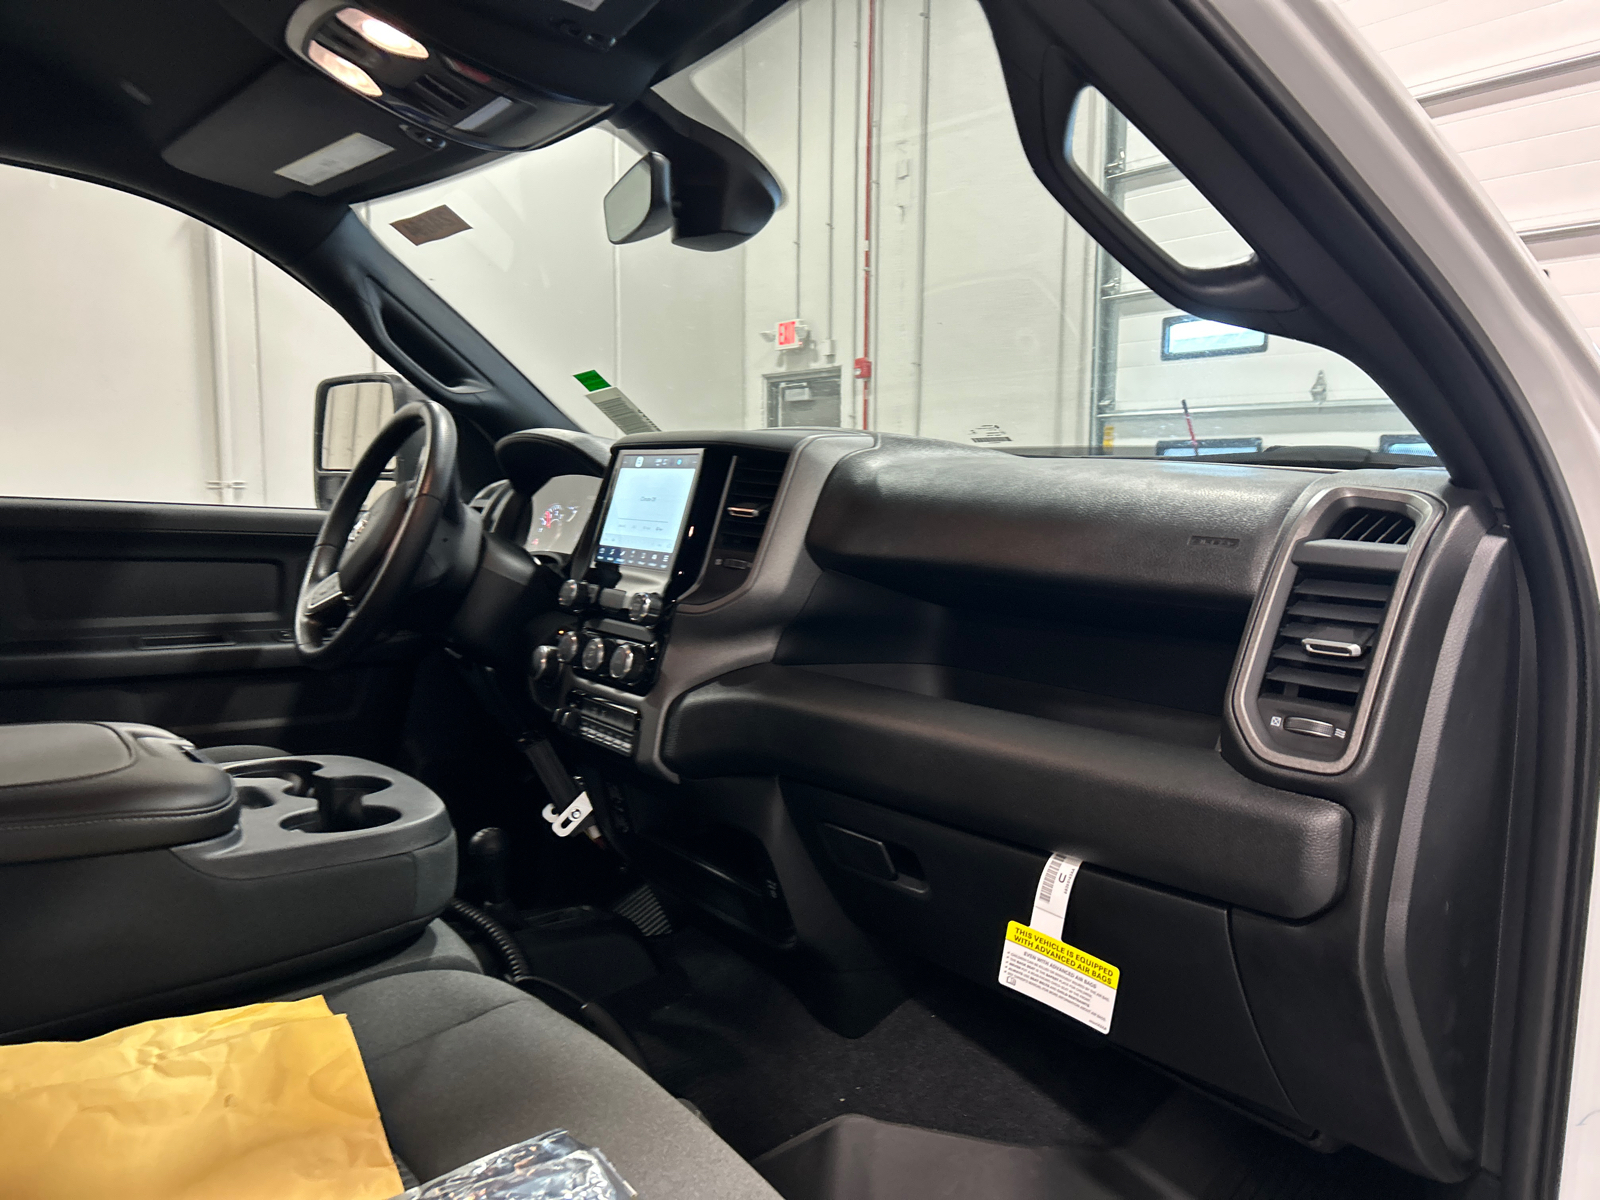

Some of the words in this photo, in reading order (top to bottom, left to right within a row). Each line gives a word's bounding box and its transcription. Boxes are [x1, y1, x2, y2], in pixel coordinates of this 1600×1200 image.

[778, 321, 796, 345] EXIT
[1013, 934, 1034, 948] WITH
[1034, 944, 1076, 967] ADVANCED
[1076, 964, 1090, 975] AIR
[1091, 970, 1112, 985] BAGS
[1015, 927, 1033, 940] THIS
[1034, 934, 1065, 954] VEHICLE
[1066, 949, 1075, 958] IS
[1075, 953, 1114, 977] EQUIPPED
[1023, 951, 1036, 961] EVEN
[1037, 956, 1049, 966] WITH
[1049, 962, 1075, 978] ADVANCED
[1075, 974, 1083, 983] AIR
[1083, 978, 1097, 989] BAGS
